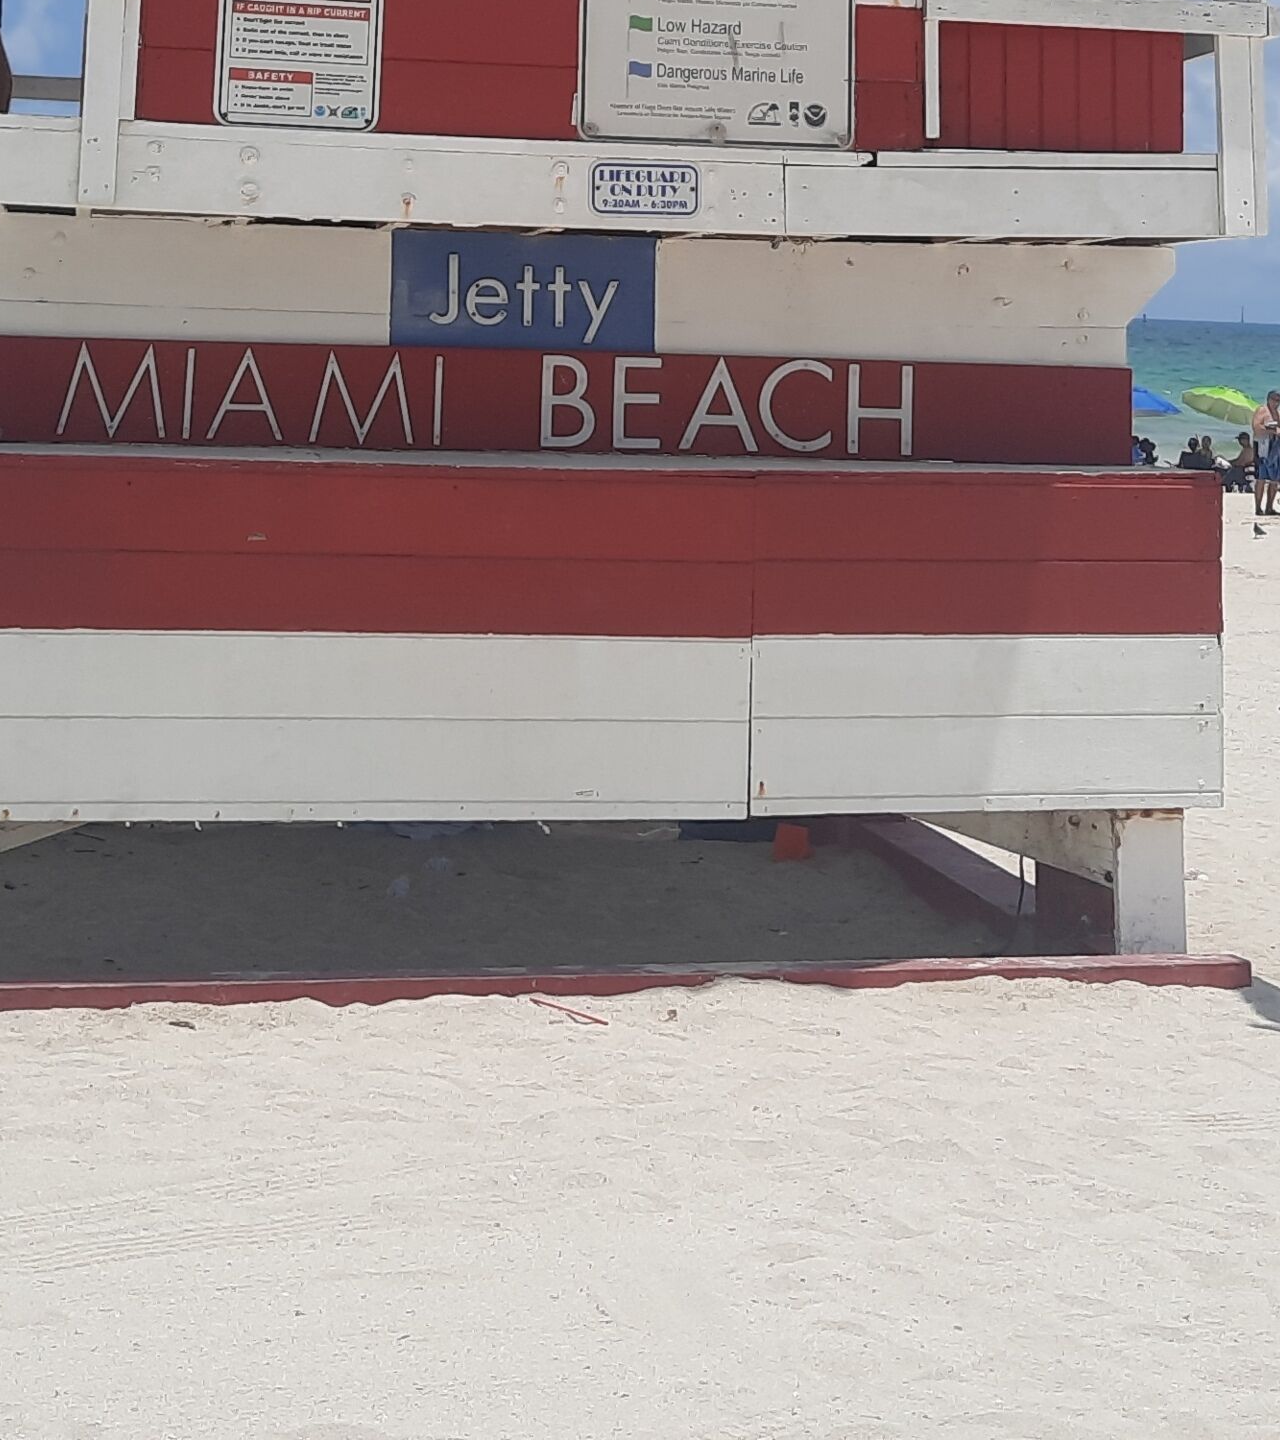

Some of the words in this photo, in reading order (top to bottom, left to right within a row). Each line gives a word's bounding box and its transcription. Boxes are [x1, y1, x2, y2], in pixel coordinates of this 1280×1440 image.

[306, 7, 322, 15] RIP
[324, 8, 367, 18] CURRENT
[657, 17, 686, 33] Low
[691, 19, 742, 35] Hazard
[247, 71, 294, 81] SAFETY
[657, 63, 727, 82] Dangerous
[732, 67, 776, 82] Marine
[780, 68, 804, 84] Life
[598, 169, 692, 184] LIFEGUARD
[609, 183, 632, 196] ON
[636, 184, 680, 197] DUTY
[429, 252, 620, 344] Jetty
[55, 340, 445, 446] MIAMI
[539, 354, 914, 456] BEACH
